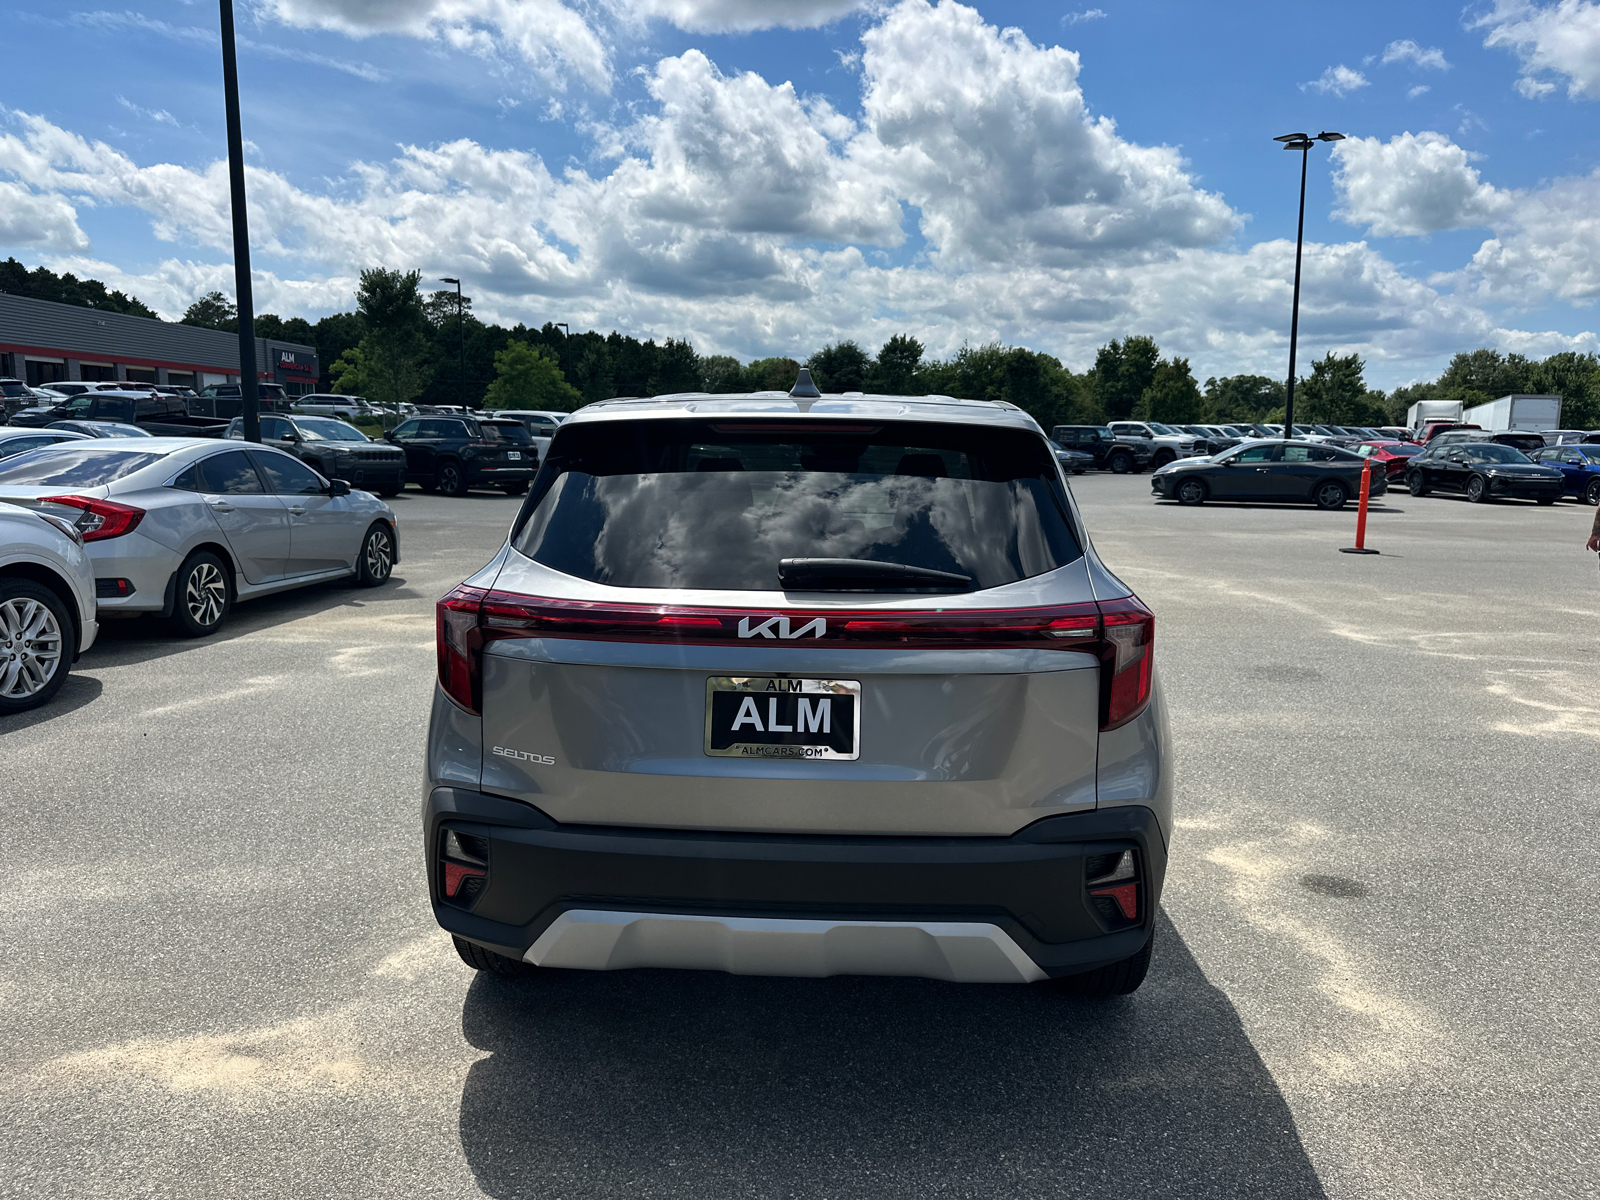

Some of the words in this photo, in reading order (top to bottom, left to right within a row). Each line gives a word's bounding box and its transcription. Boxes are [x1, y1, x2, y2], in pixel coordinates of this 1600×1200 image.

[281, 351, 295, 363] ALM
[738, 616, 827, 639] KIA
[766, 680, 803, 692] ALM
[730, 696, 832, 733] ALM
[493, 746, 555, 766] SELTOS
[741, 746, 823, 757] ALMCARS.COM
